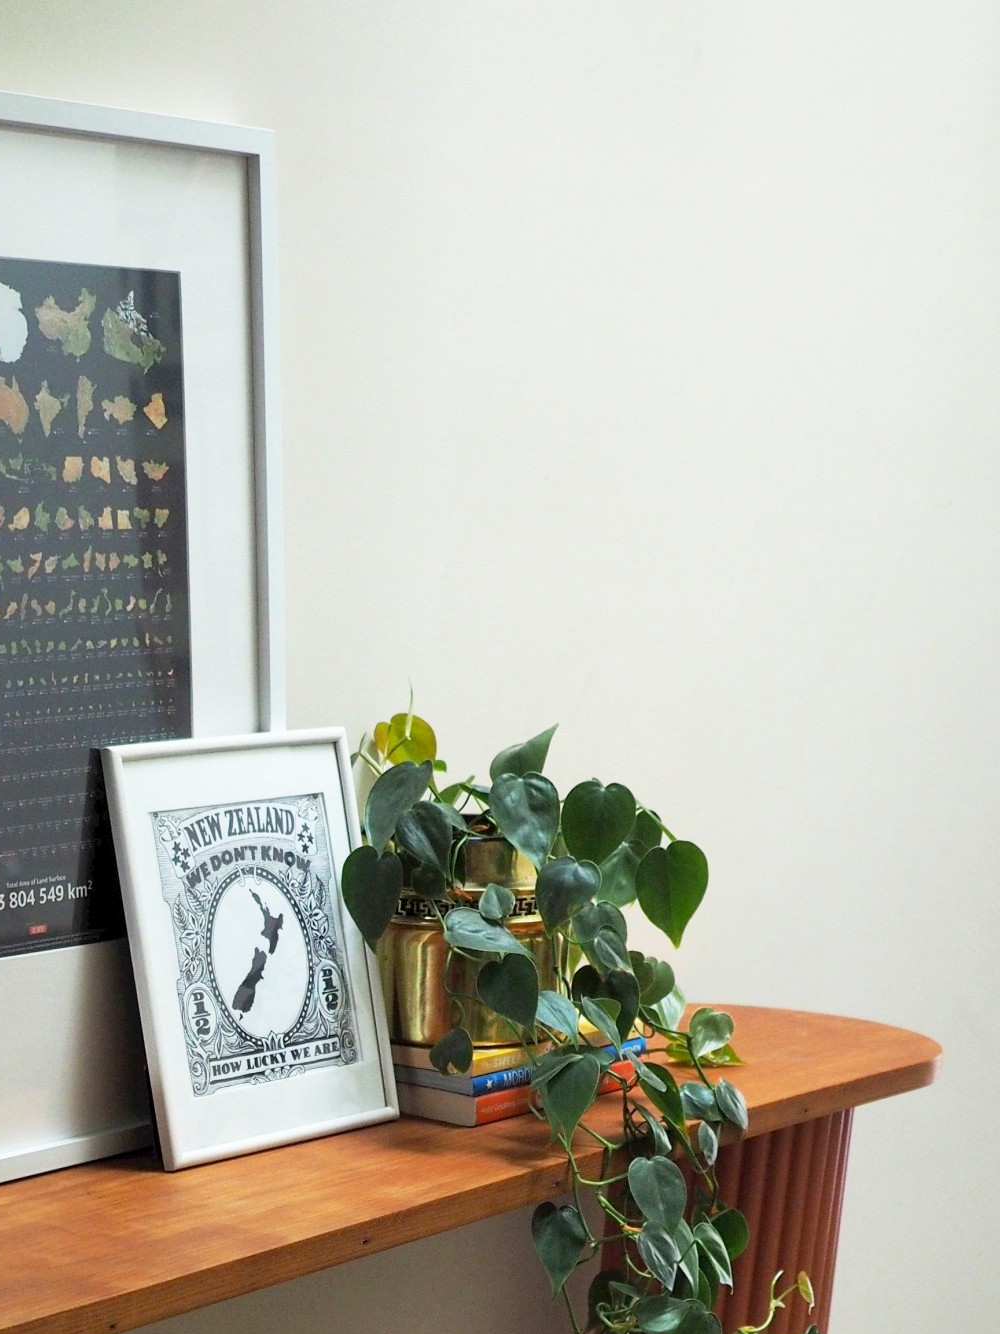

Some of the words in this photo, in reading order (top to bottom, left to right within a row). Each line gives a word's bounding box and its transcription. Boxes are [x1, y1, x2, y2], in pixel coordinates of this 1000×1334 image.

[184, 812, 223, 851] NEW
[224, 806, 295, 837] ZEALAND
[31, 878, 36, 886] of
[36, 876, 48, 884] Land
[49, 874, 67, 883] Surface
[186, 861, 212, 888] WE
[210, 846, 258, 872] DON'T
[261, 846, 311, 871] KNOW
[9, 889, 36, 909] 804
[39, 885, 64, 904] 549
[212, 1060, 242, 1077] HOW
[246, 1052, 287, 1070] LUCKY
[290, 1046, 311, 1061] WE
[314, 1041, 340, 1056] ARE
